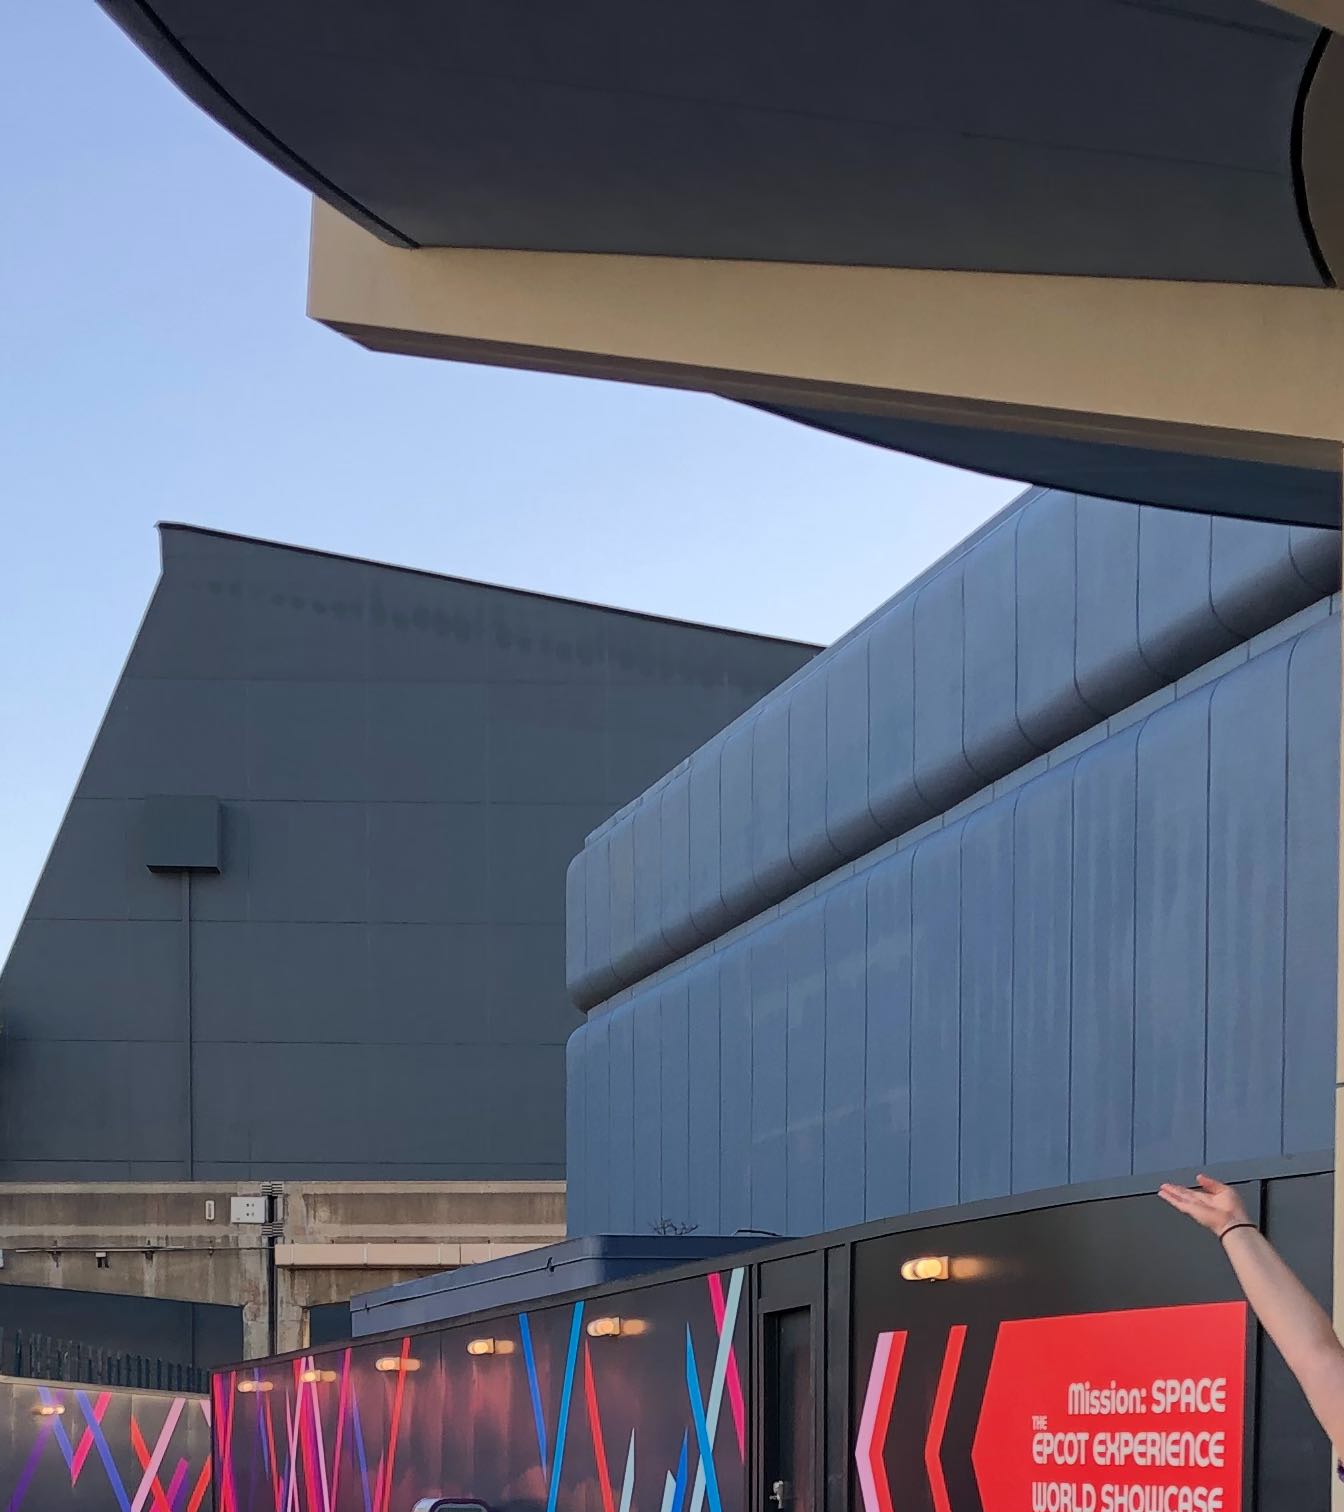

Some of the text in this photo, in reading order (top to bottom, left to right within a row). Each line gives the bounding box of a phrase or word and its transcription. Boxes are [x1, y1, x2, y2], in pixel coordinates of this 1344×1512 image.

[1067, 1377, 1227, 1415] Mission: SPACE
[1031, 1415, 1048, 1431] THE
[1032, 1430, 1226, 1468] EPCOT EXPERIENCE
